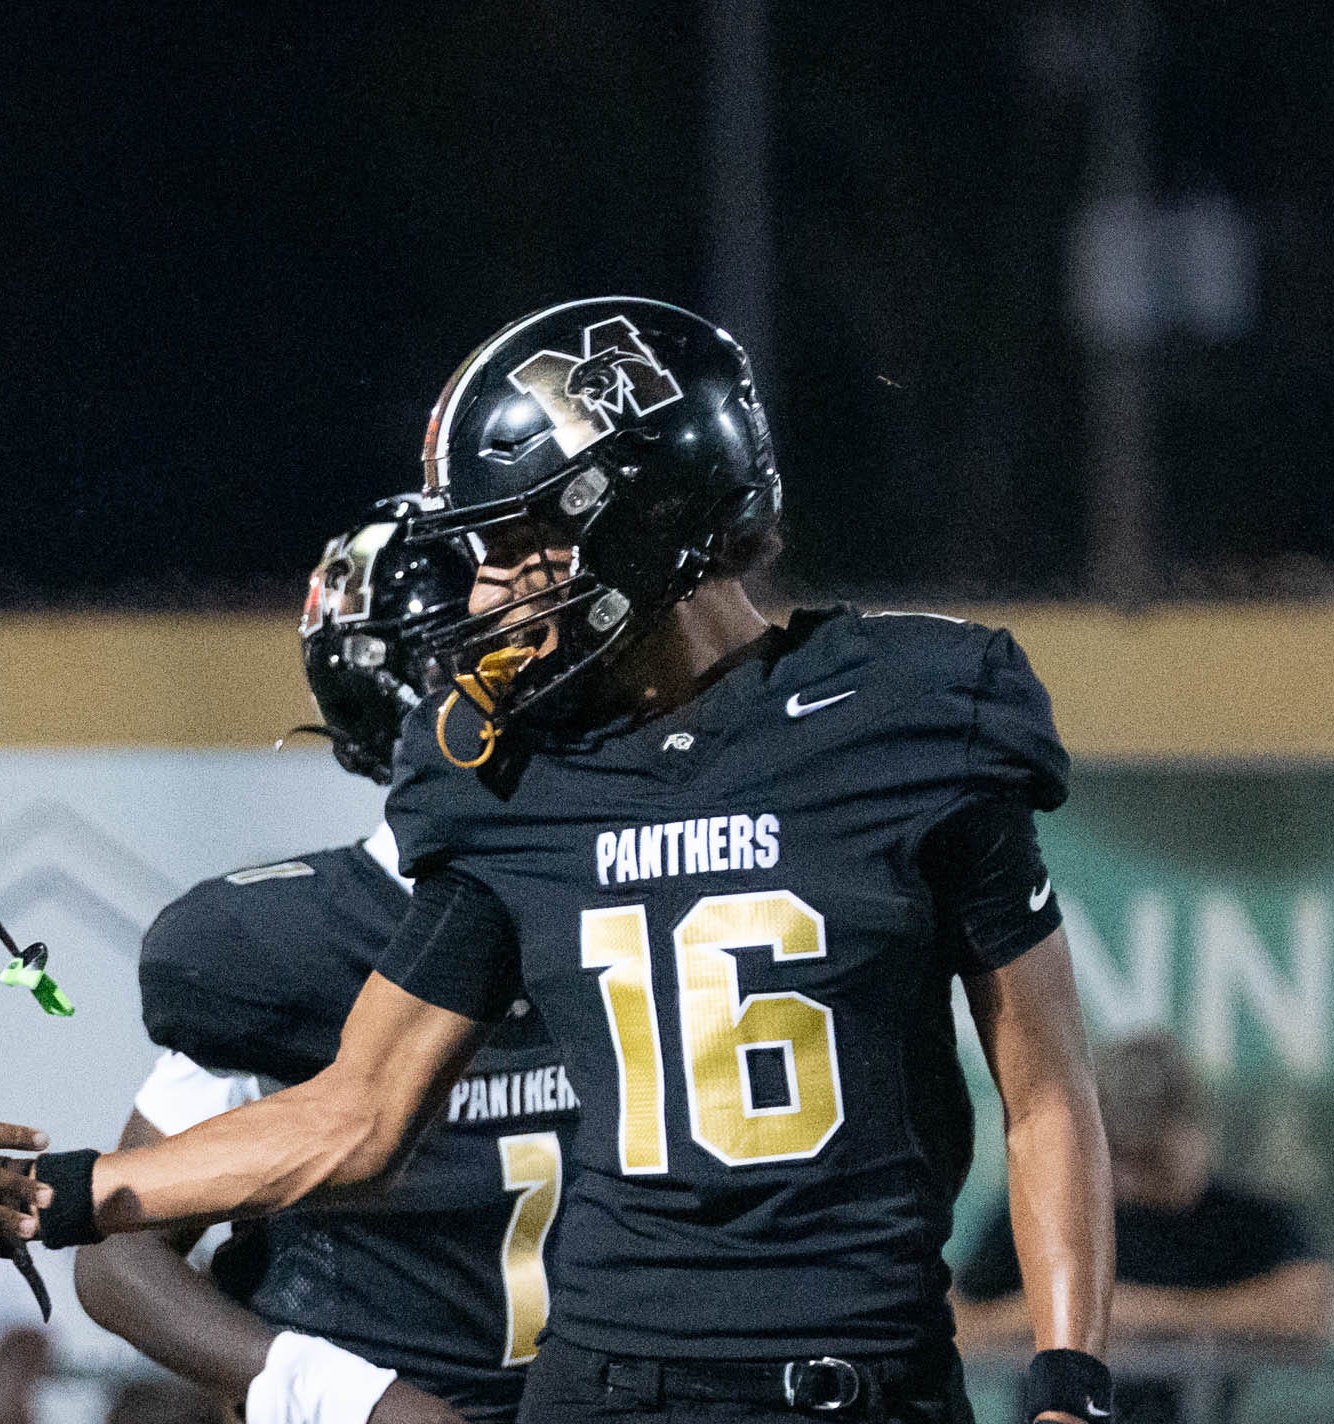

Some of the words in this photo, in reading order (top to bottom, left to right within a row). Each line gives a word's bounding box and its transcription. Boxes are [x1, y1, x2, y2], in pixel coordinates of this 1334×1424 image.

[596, 813, 780, 886] PANTHERS
[580, 889, 846, 1176] 16
[498, 1130, 562, 1368] 7
